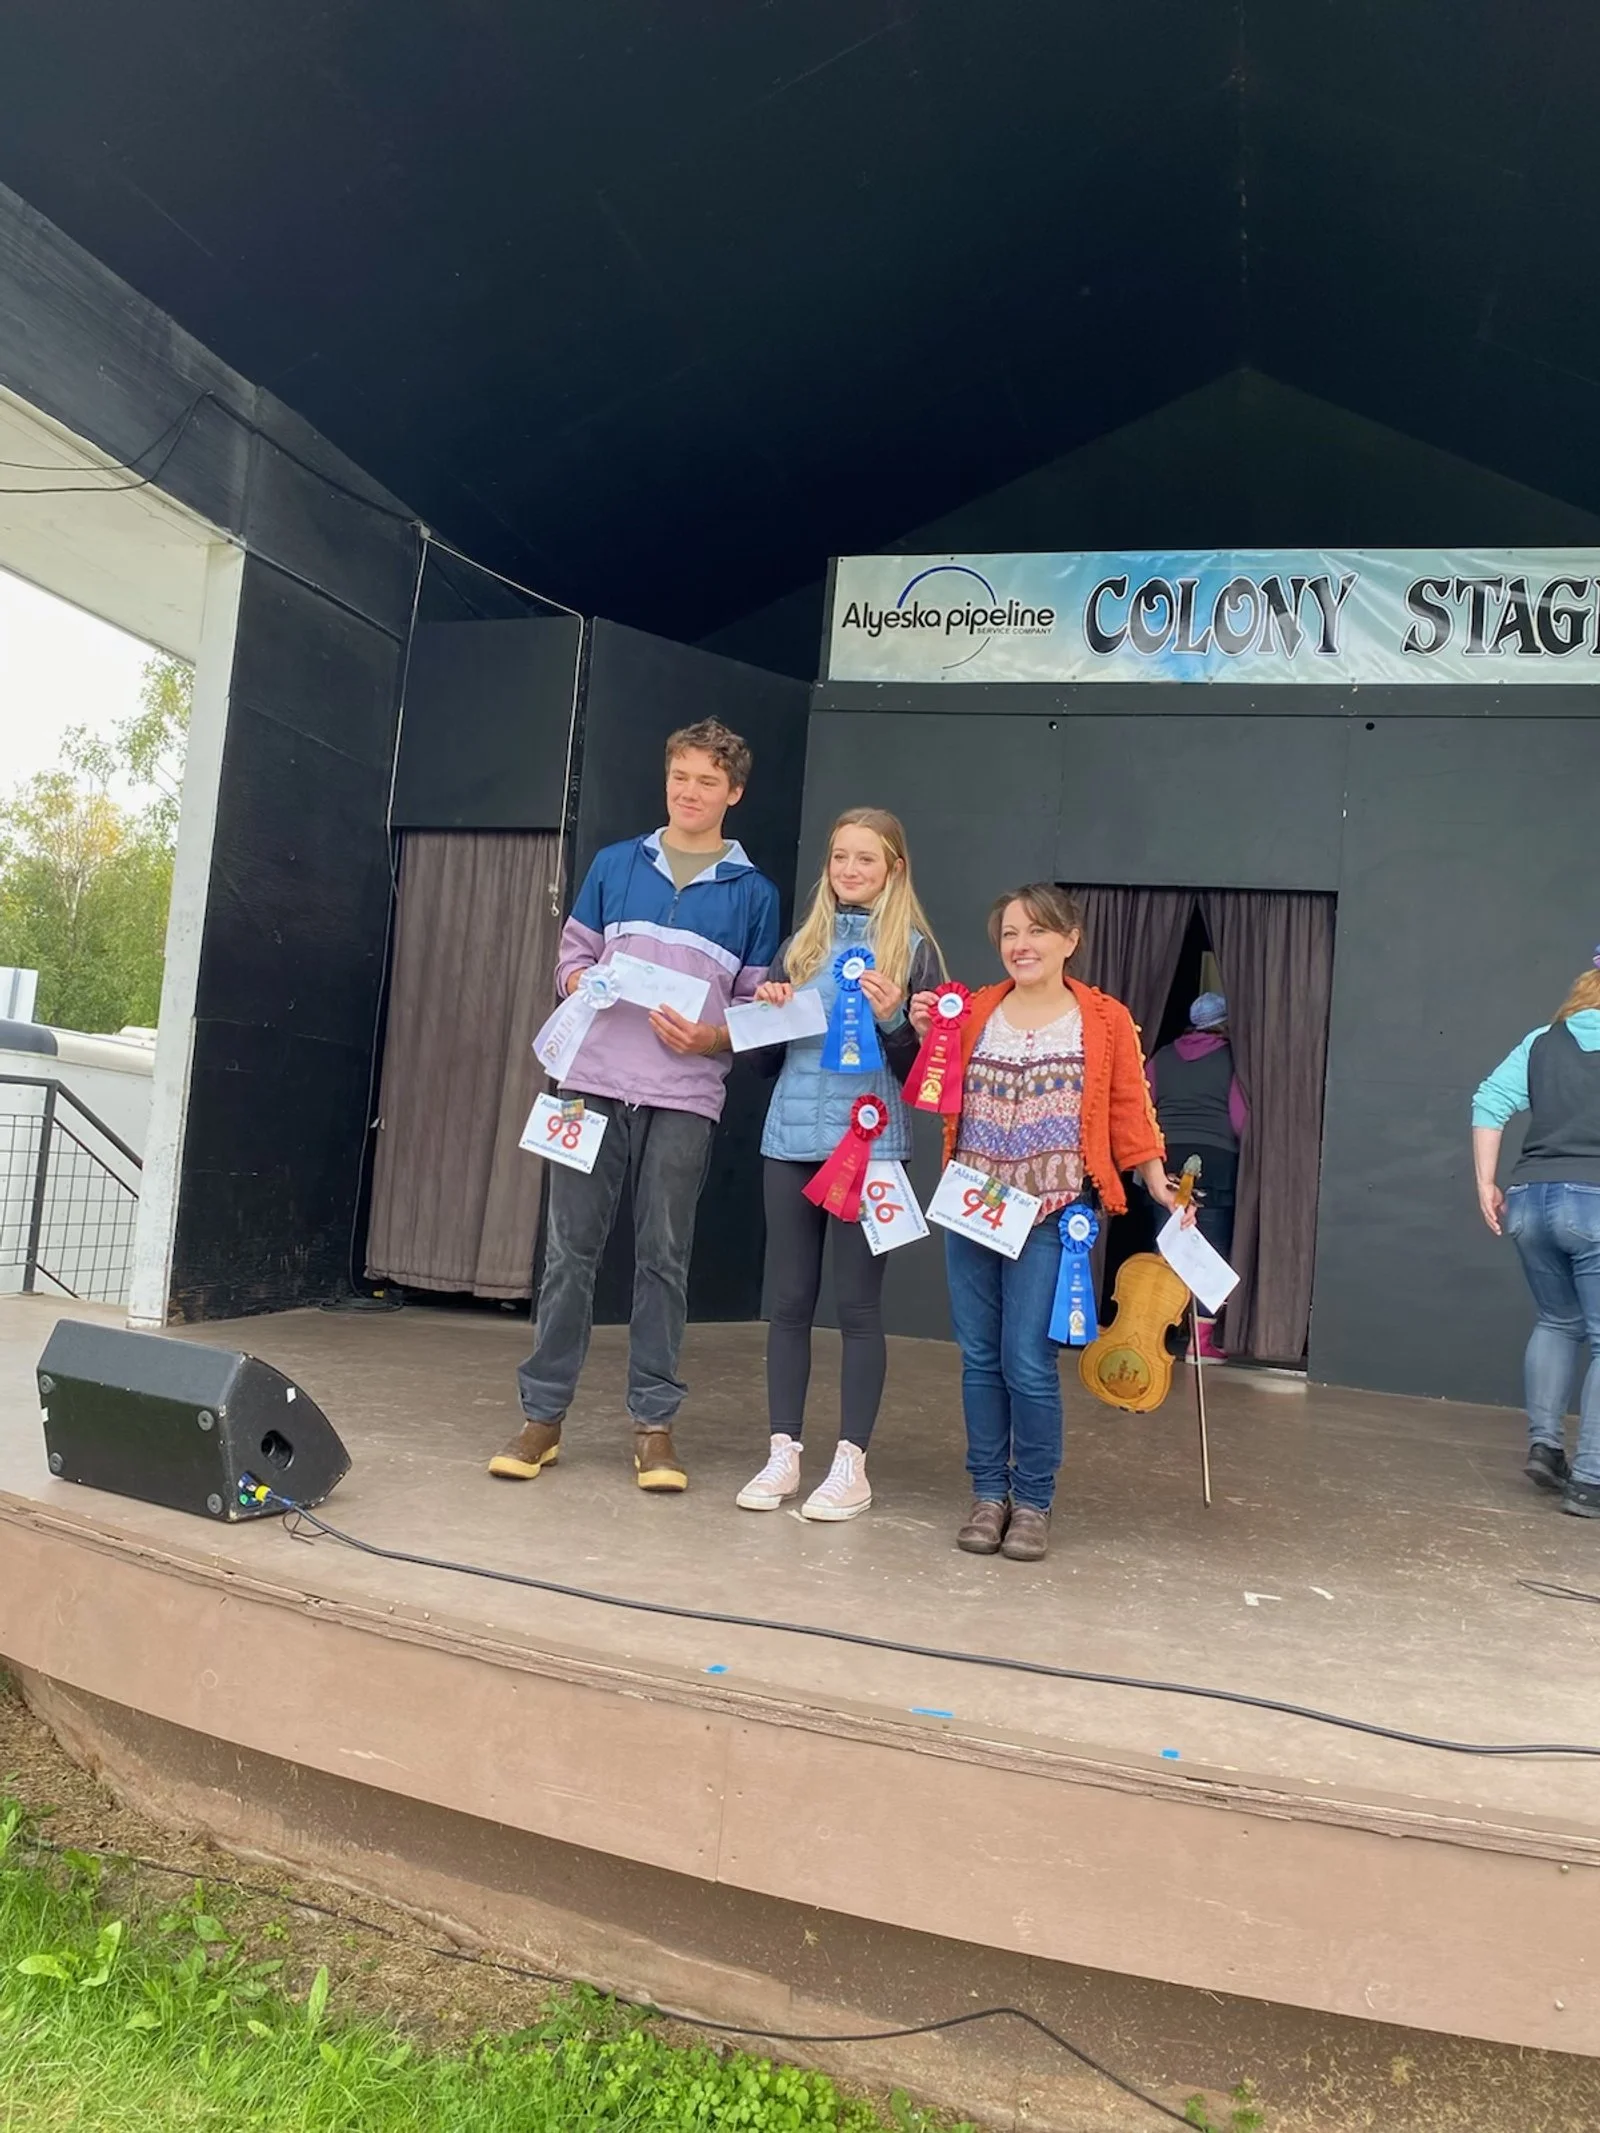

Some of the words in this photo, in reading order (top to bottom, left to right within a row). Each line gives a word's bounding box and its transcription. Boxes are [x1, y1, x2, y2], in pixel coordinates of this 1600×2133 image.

[842, 602, 941, 638] Alyeska
[946, 600, 1055, 635] pipeline
[976, 627, 1010, 636] SERVICE
[1012, 627, 1053, 636] COMPANY
[1082, 572, 1360, 660] COLONY
[546, 1115, 582, 1150] 98
[962, 1188, 1007, 1231] 94
[1013, 1195, 1032, 1208] Fair
